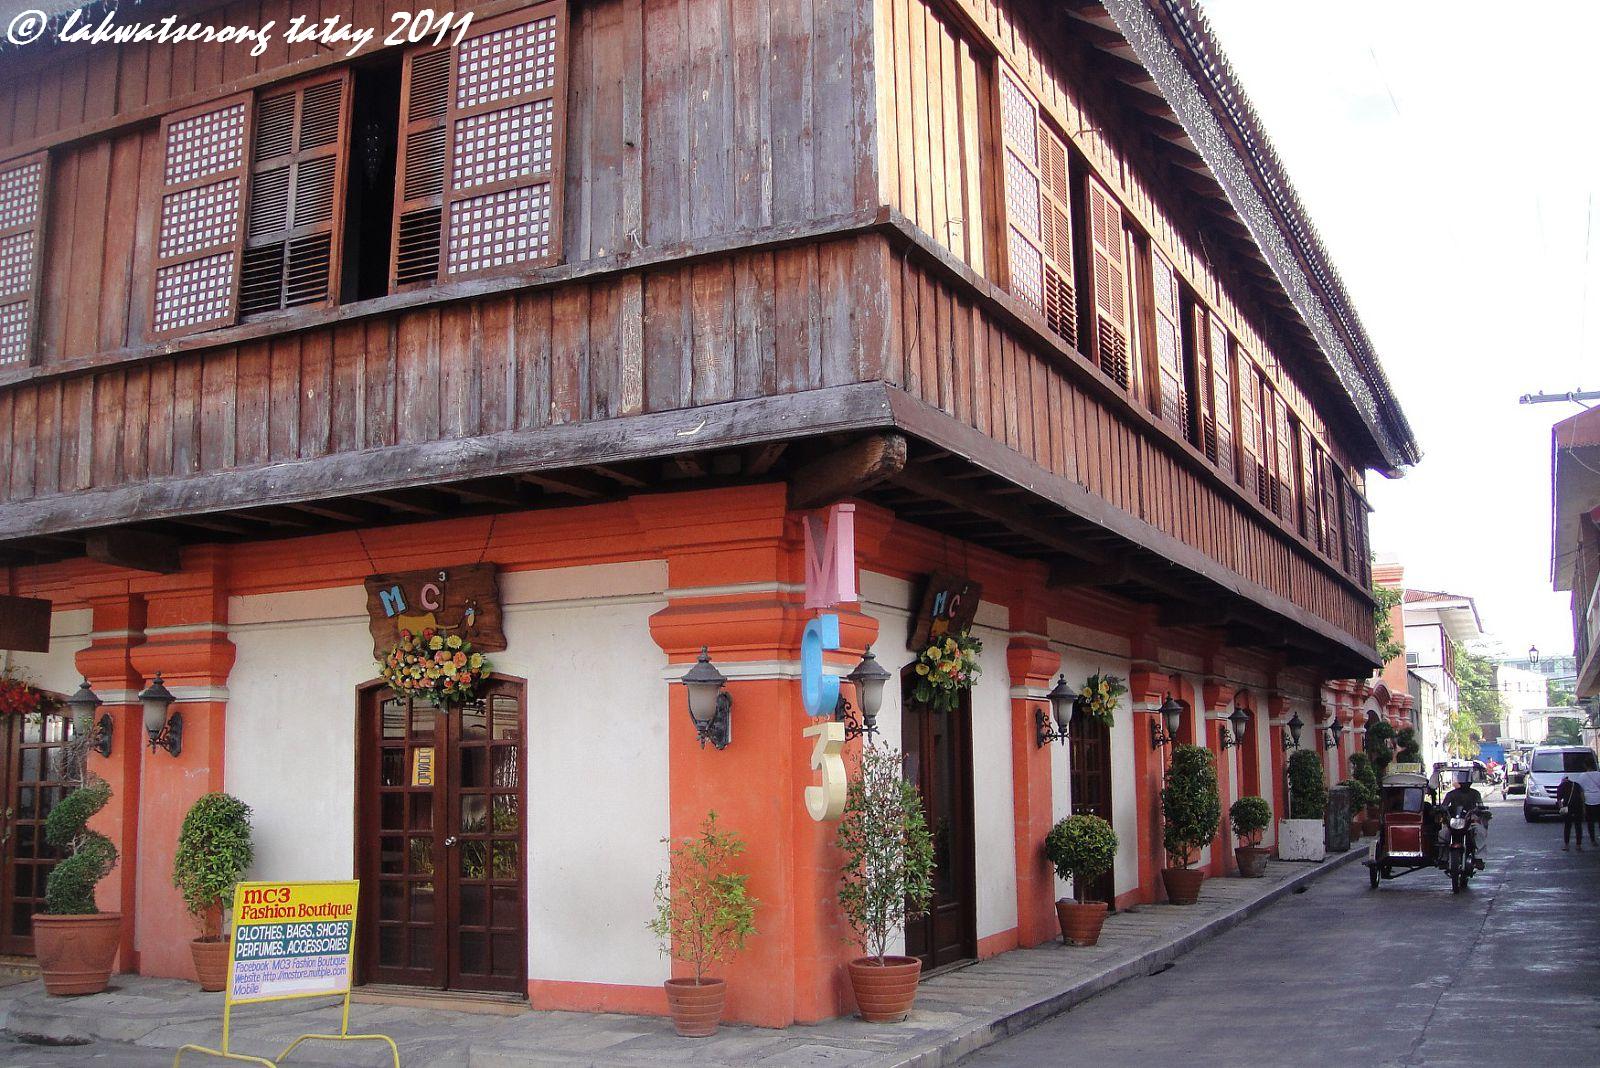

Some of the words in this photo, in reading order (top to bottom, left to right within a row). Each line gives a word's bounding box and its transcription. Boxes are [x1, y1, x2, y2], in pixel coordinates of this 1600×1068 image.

[241, 904, 296, 920] Fashion
[298, 902, 353, 919] Boutique
[316, 922, 349, 937] SHOES
[287, 937, 349, 955] ACCESSORIES
[272, 959, 291, 971] MC3
[291, 957, 316, 969] Fashion
[317, 955, 347, 967] Boutique
[233, 983, 260, 996] Mobile
